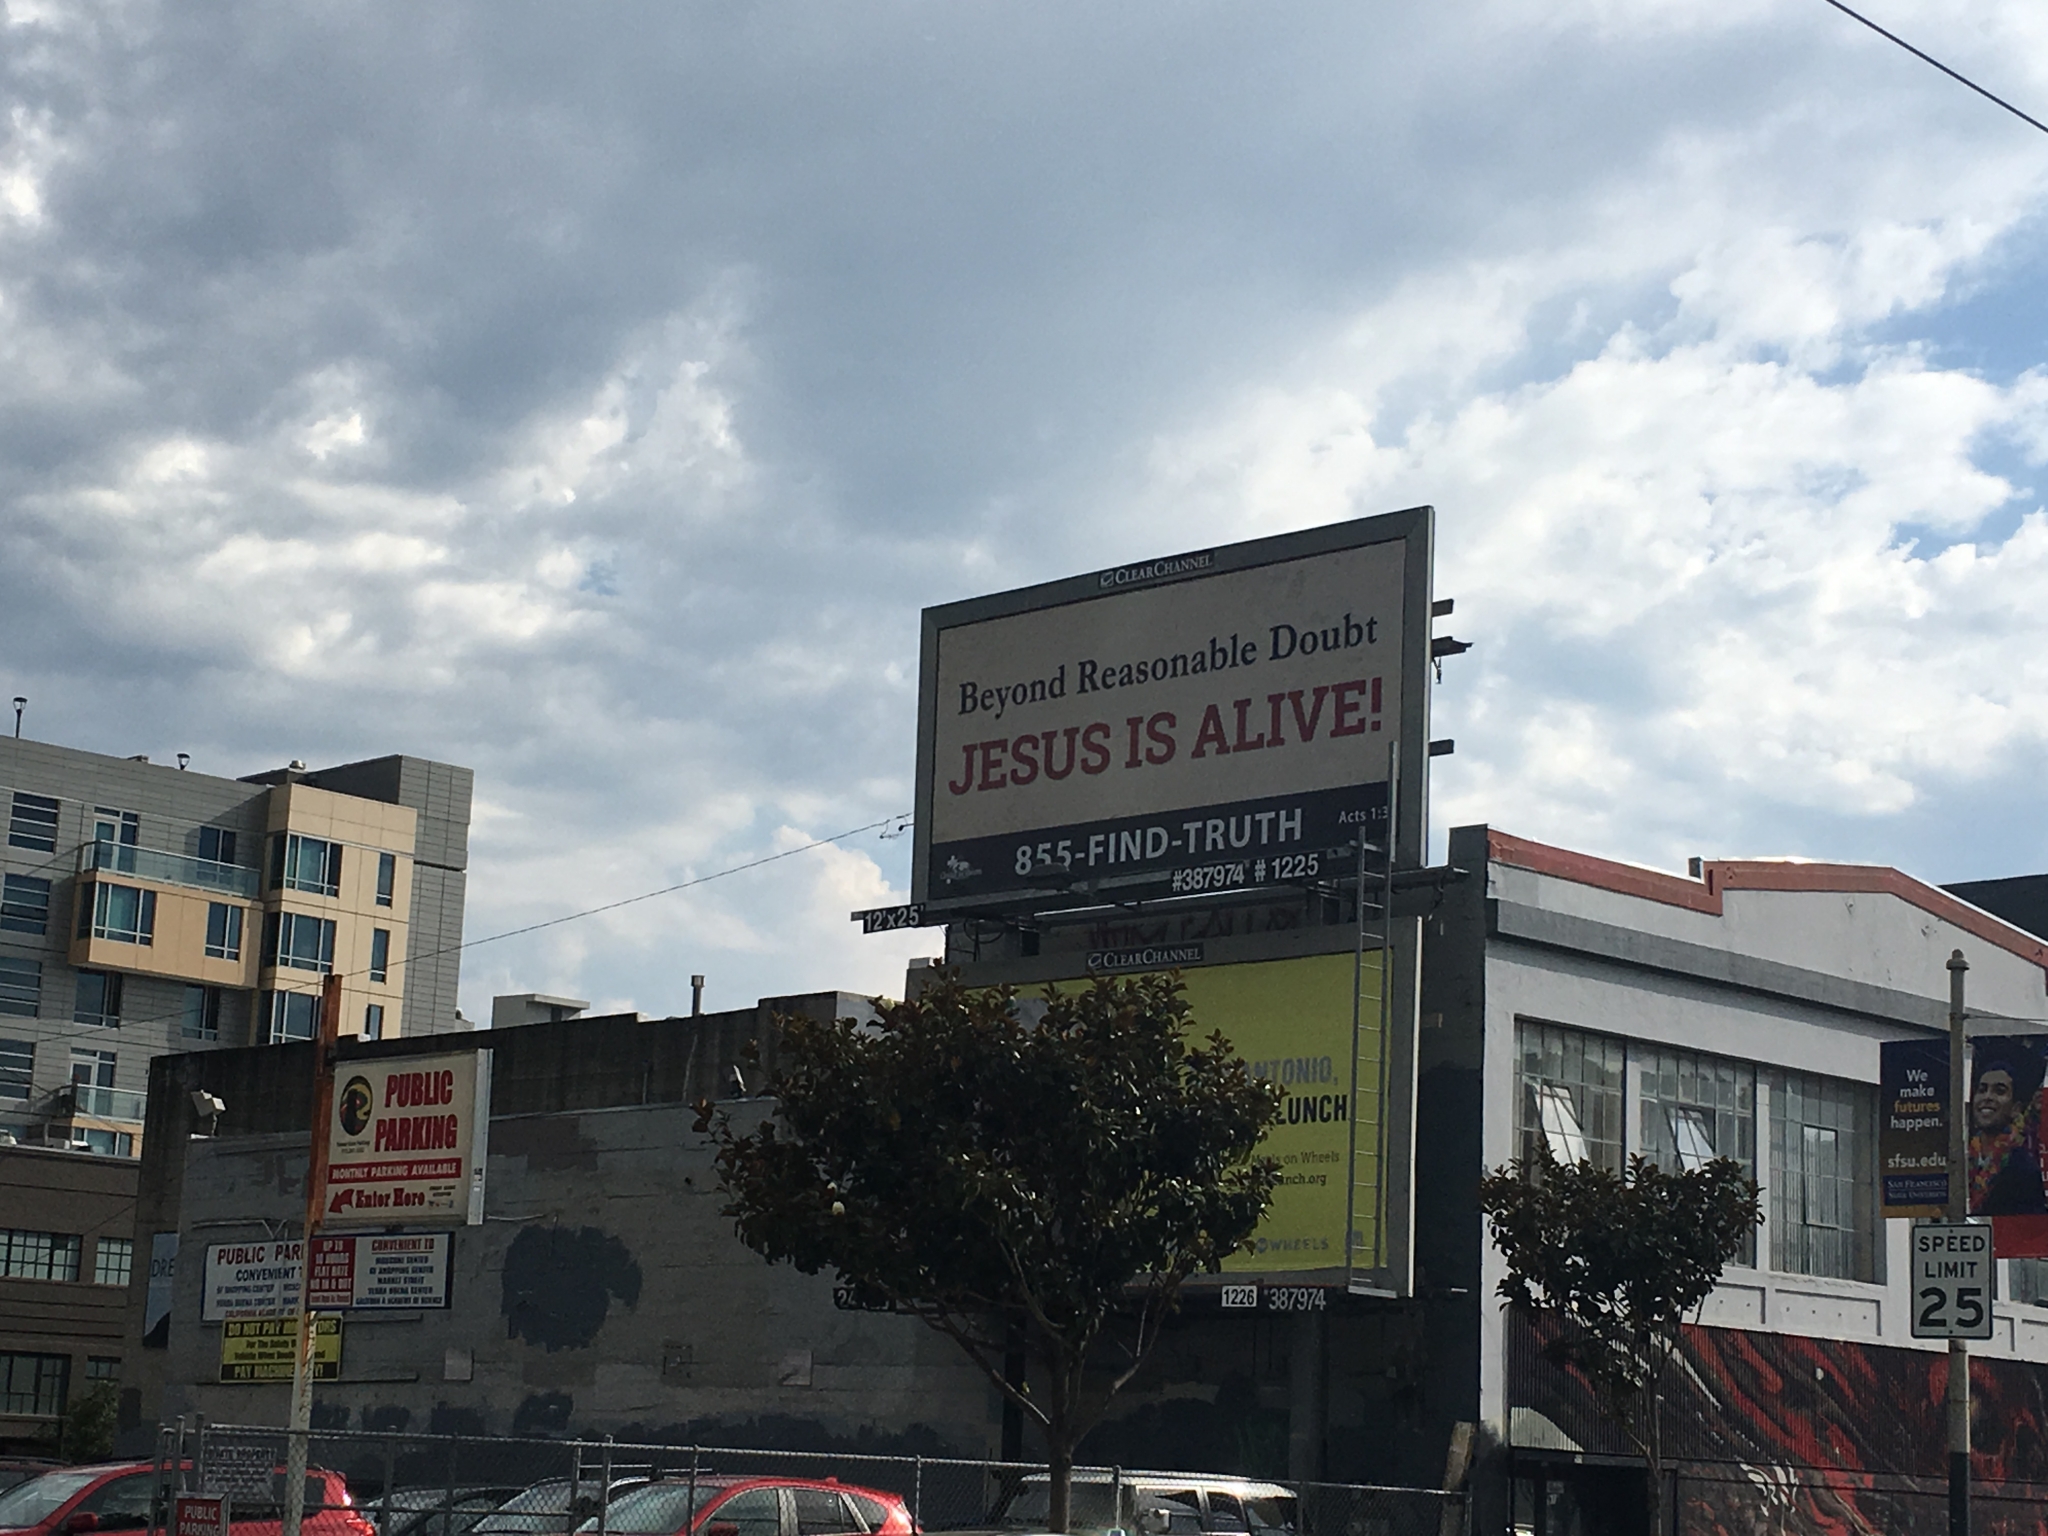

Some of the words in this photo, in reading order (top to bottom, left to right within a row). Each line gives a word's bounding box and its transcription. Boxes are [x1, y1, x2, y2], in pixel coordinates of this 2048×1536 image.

[959, 664, 1066, 720] Beyond
[1078, 640, 1257, 694] Reasonable
[1270, 613, 1378, 662] Doubt
[949, 722, 1111, 796] JESUS
[1125, 711, 1177, 769] IS
[1191, 677, 1383, 759] ALIVE!
[1338, 810, 1367, 824] Acts
[1014, 808, 1302, 876] 855-FIND-TRUTH
[1171, 863, 1245, 892] #387974
[1271, 853, 1319, 880] 1225
[1906, 1069, 1928, 1083] We
[384, 1069, 453, 1108] PUBLIC
[1900, 1083, 1935, 1098] make
[1894, 1100, 1941, 1114] futures
[1890, 1114, 1944, 1132] happen.
[374, 1113, 458, 1153] PARKING
[1301, 1150, 1340, 1164] Wheels
[1887, 1153, 1947, 1170] sfsu.edu
[331, 1167, 369, 1180] MONTHLY
[370, 1164, 409, 1178] PARKING
[411, 1162, 457, 1176] AVAILABLE
[355, 1189, 391, 1208] Enter
[392, 1187, 425, 1207] Here
[1918, 1235, 1985, 1253] SPEED
[217, 1246, 266, 1265] PUBLIC
[236, 1266, 296, 1282] CONVENIENT
[1924, 1261, 1978, 1279] LIMIT
[1223, 1288, 1255, 1306] 1226
[1268, 1287, 1327, 1310] 387974
[1918, 1287, 1984, 1328] 25
[228, 1322, 241, 1337] DO
[242, 1322, 262, 1336] NOT
[262, 1321, 282, 1335] PAY
[234, 1365, 252, 1379] PAY
[184, 1505, 218, 1521] PUBLIC
[179, 1521, 220, 1536] PARKING
